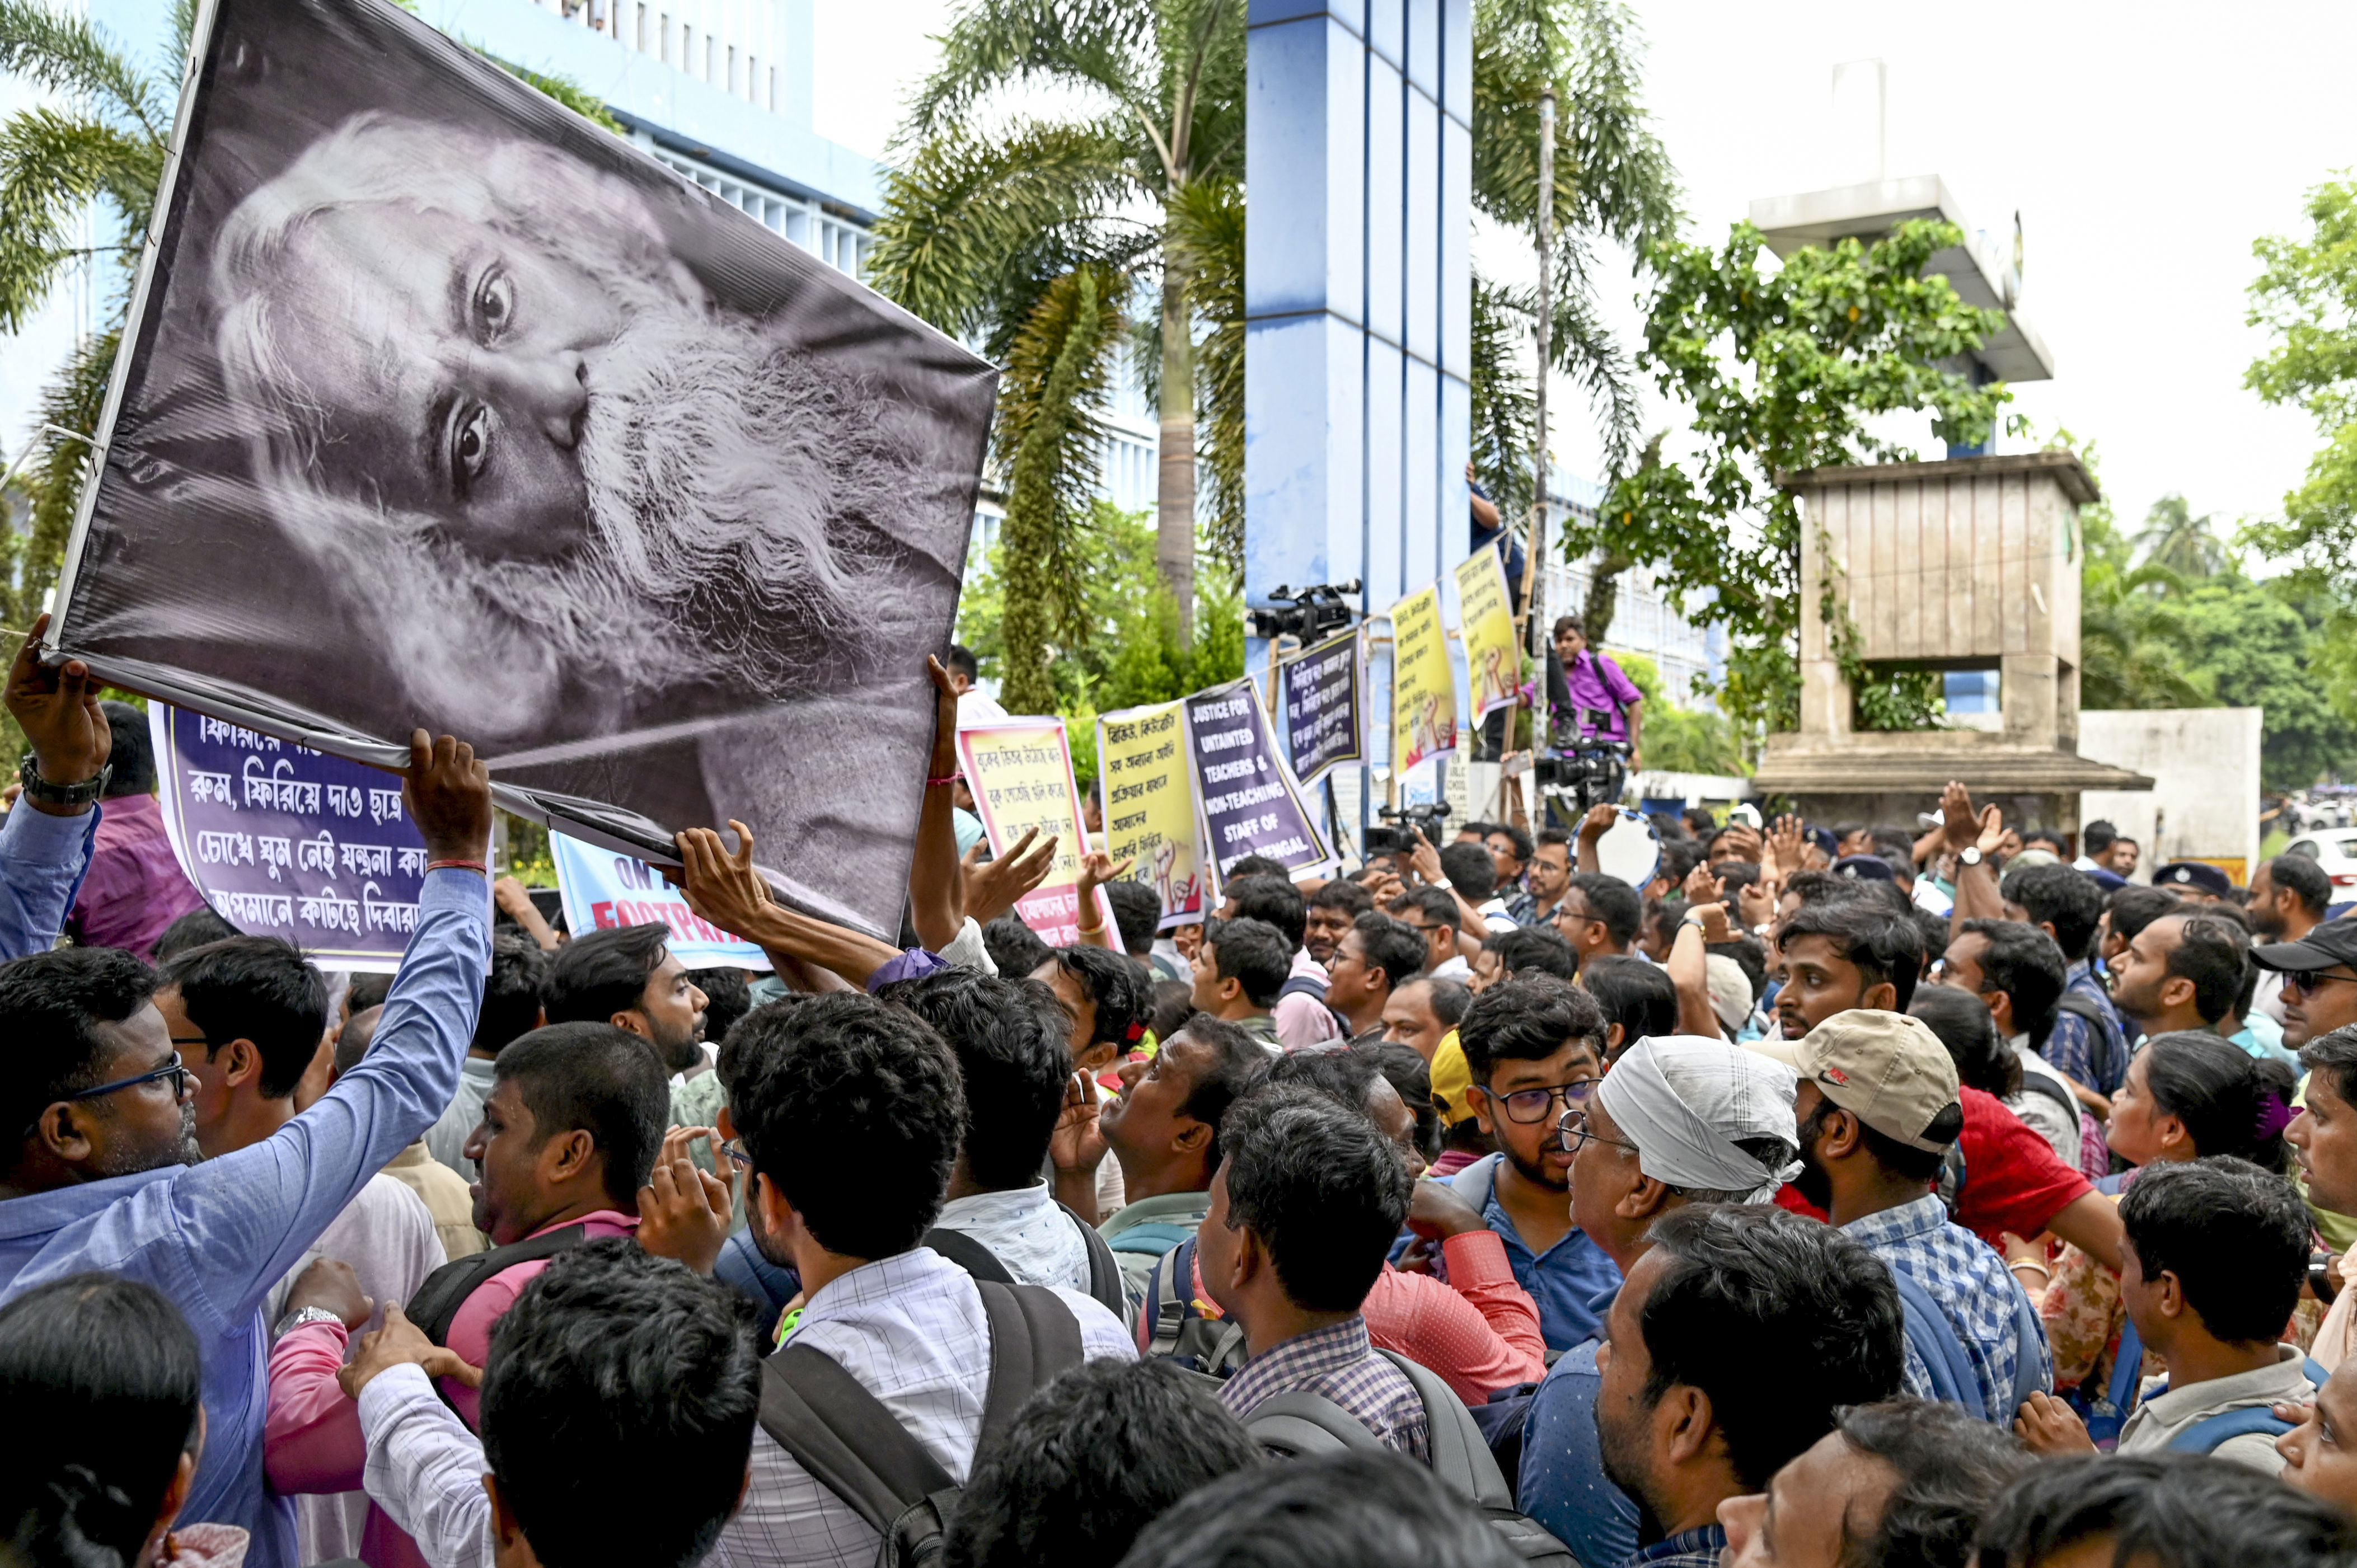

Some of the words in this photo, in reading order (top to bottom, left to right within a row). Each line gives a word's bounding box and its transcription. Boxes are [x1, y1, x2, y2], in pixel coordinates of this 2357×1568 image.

[1193, 701, 1230, 723] JUSTICE
[1229, 698, 1250, 716] FOR
[1200, 728, 1254, 753] UNTAINTED
[1204, 758, 1255, 783] TEACHERS
[1257, 755, 1268, 771] &
[188, 769, 237, 811] রুম,
[242, 755, 321, 815] ফিরিয়ে
[327, 784, 363, 818] দাও
[1205, 781, 1286, 815] NON-TEACHING
[1224, 818, 1259, 843] STAFF
[1260, 813, 1278, 831] OF
[197, 830, 254, 867] চোখে
[257, 836, 292, 882] ঘুম
[298, 830, 337, 880] নেই
[397, 847, 428, 879] কা
[614, 857, 653, 891] ON
[208, 889, 294, 927] অপমানে
[297, 886, 361, 937] কাটছে
[363, 881, 422, 933] দিবারা
[591, 899, 747, 943] FOOTPA
[1828, 1066, 1849, 1084] NIKE
